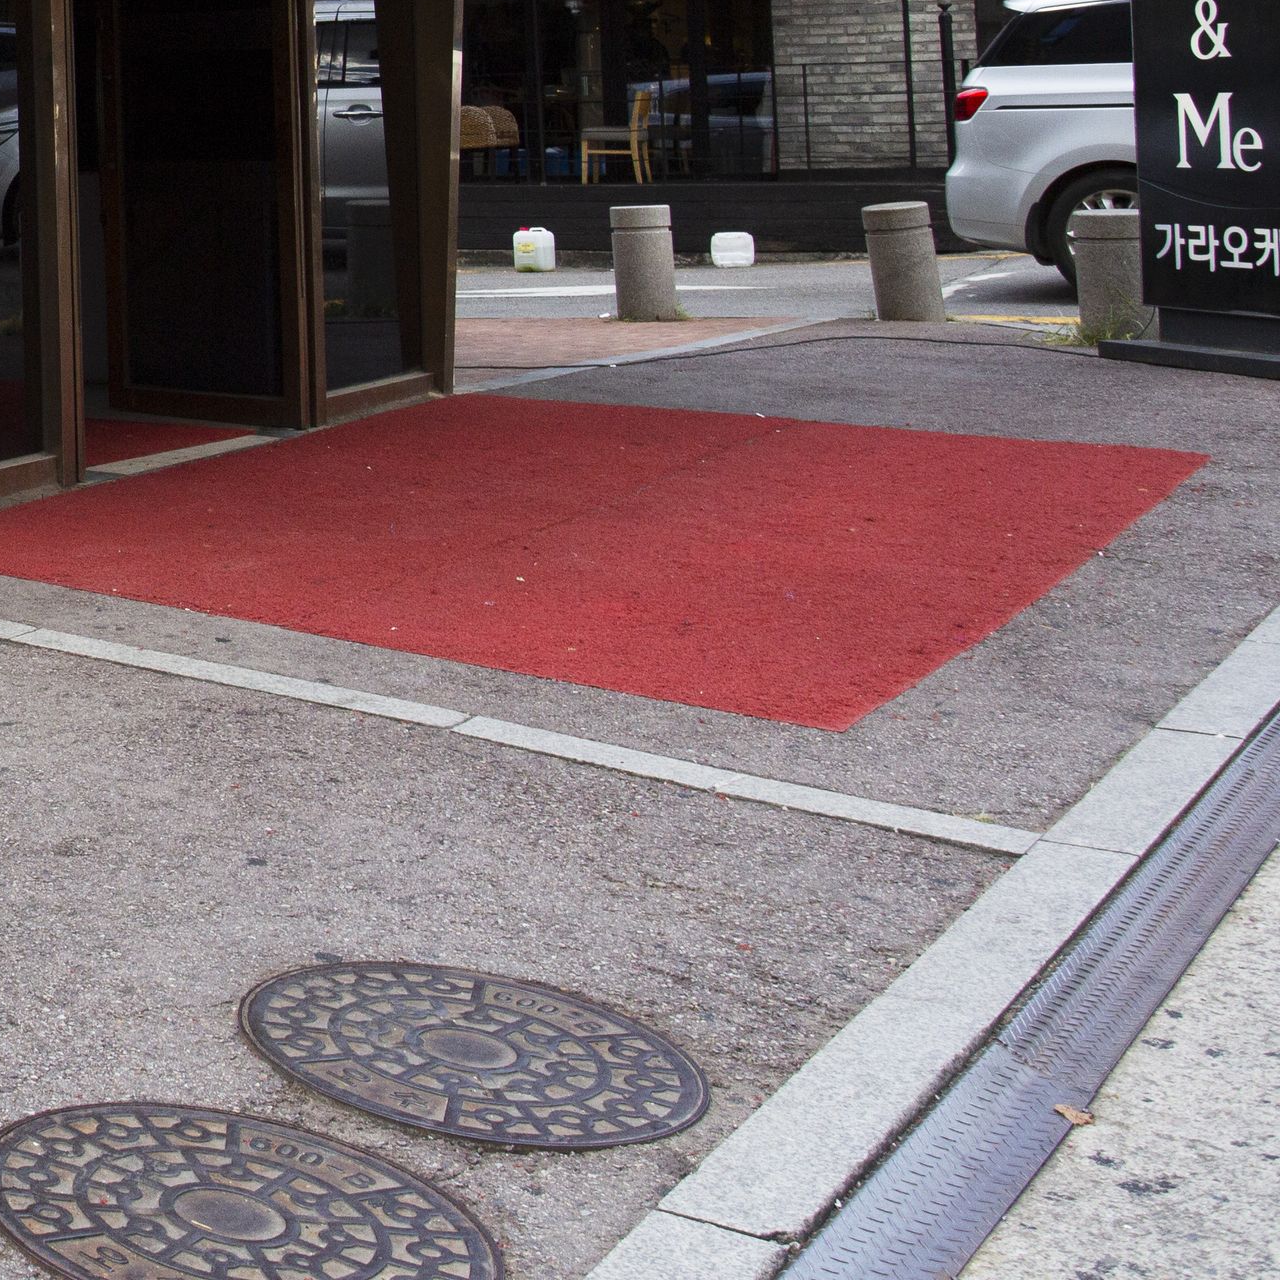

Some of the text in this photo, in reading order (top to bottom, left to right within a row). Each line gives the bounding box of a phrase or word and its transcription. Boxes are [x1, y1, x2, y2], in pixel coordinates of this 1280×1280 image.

[1172, 91, 1264, 172] Me
[1154, 223, 1280, 277] 가라오케
[249, 1136, 378, 1189] 600-B
